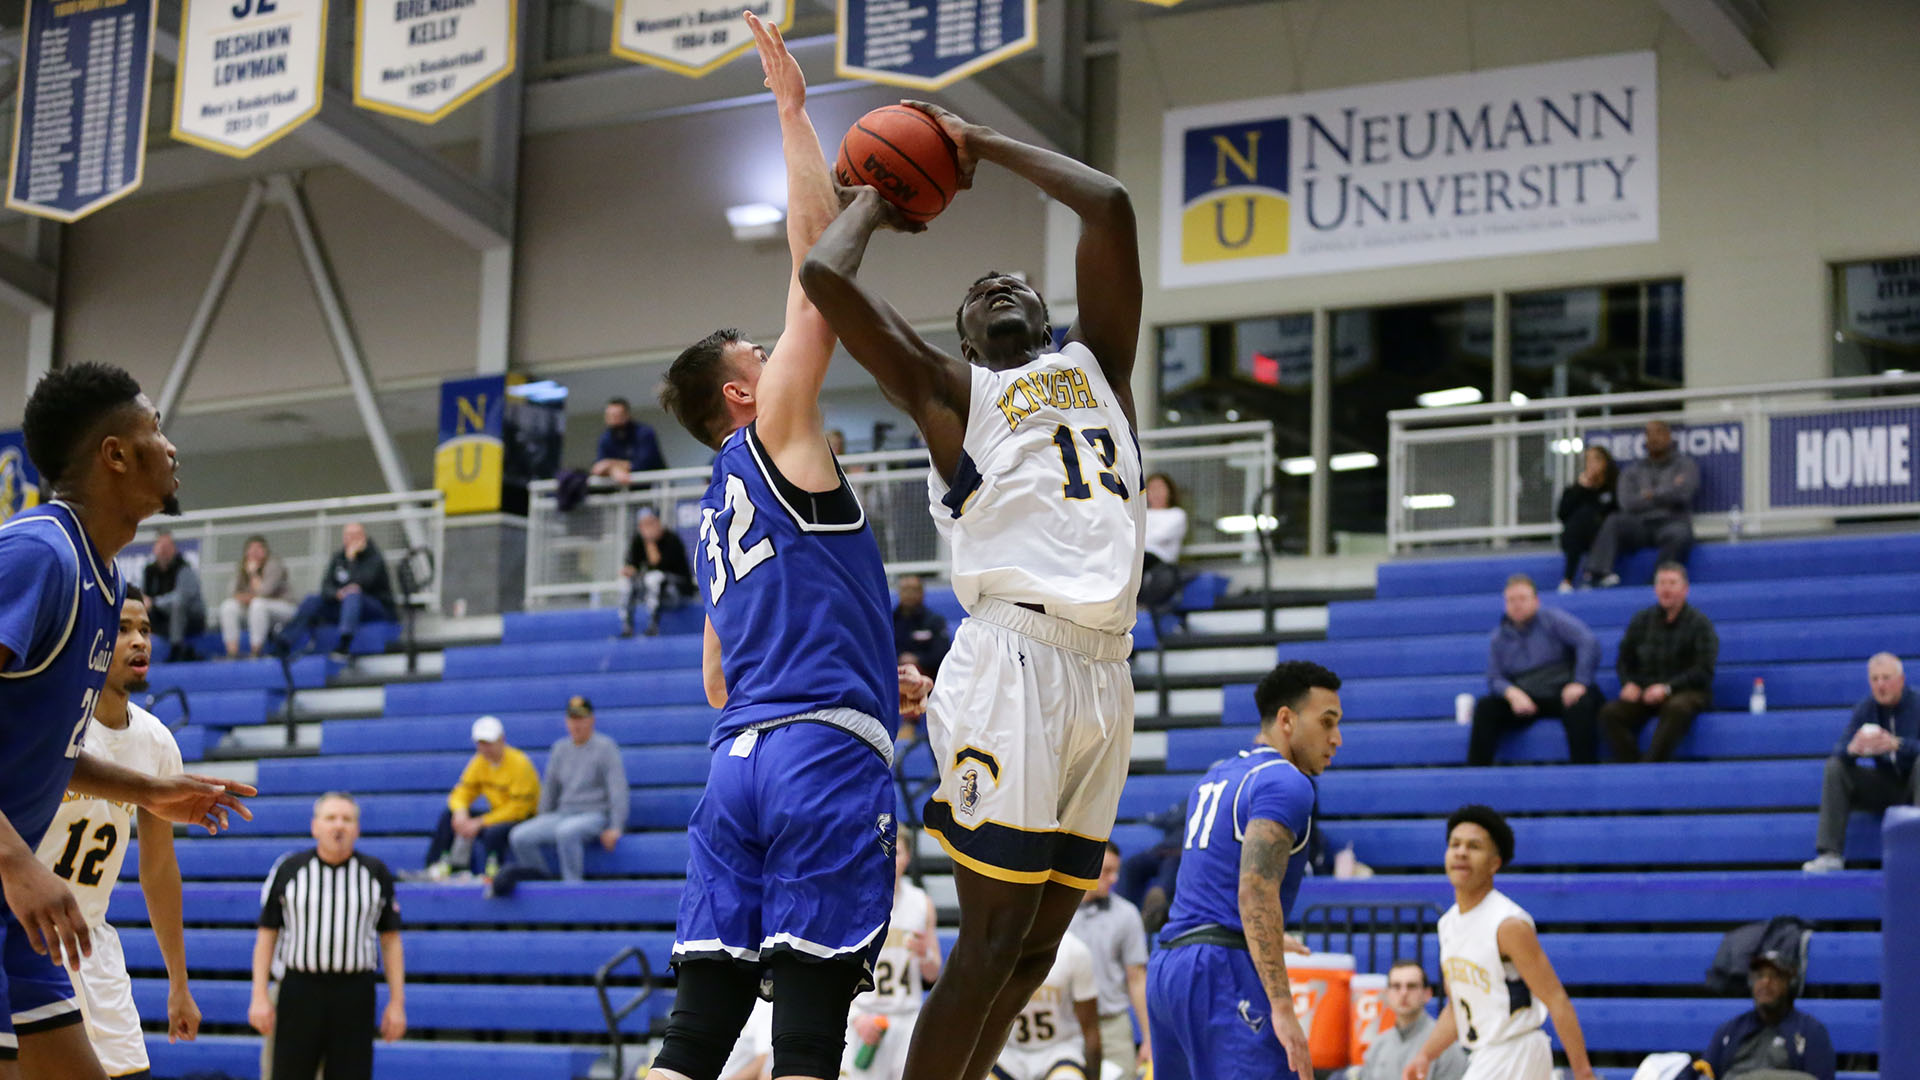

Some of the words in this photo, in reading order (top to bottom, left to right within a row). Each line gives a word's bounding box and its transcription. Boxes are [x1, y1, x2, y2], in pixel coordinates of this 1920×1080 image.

[214, 25, 291, 61] DESHAWN
[408, 17, 460, 46] KELLY
[214, 53, 287, 87] LOWMAN
[1303, 86, 1639, 172] NEUMANN
[1212, 130, 1262, 187] N
[1302, 155, 1640, 231] UNIVERSITY
[1214, 197, 1258, 249] U
[456, 393, 487, 435] N
[997, 367, 1099, 433] KNIGH
[456, 443, 484, 484] U
[1052, 423, 1130, 502] 13
[1795, 424, 1911, 491] HOME
[700, 474, 776, 608] 32
[1184, 779, 1229, 850] 11
[53, 818, 118, 887] 12
[877, 960, 912, 997] 24
[1016, 1010, 1055, 1043] 35
